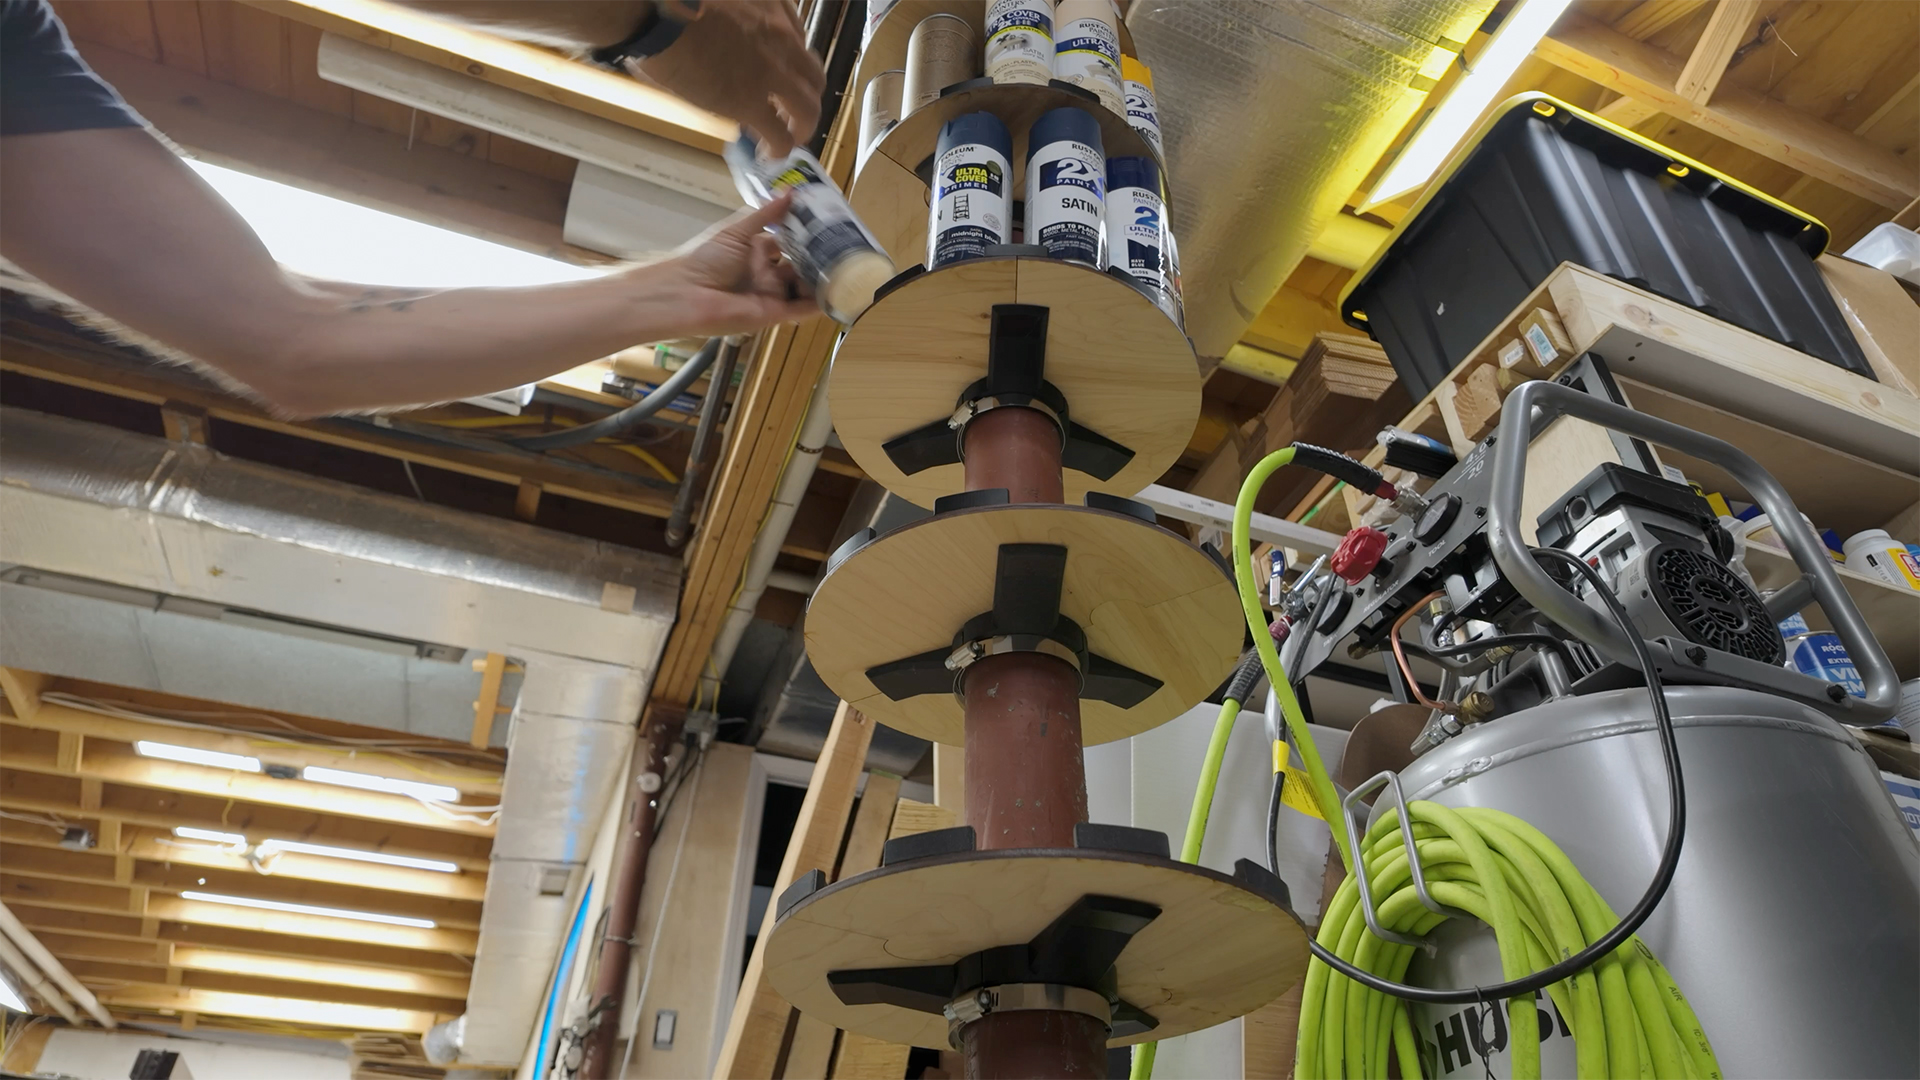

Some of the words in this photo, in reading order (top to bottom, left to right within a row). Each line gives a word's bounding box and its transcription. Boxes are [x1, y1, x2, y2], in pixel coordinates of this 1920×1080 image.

[1007, 10, 1041, 21] COVER
[1072, 38, 1105, 48] ULTRA
[1129, 110, 1150, 120] AINT
[955, 167, 988, 178] ULTRA
[1056, 158, 1103, 191] 2X
[955, 174, 988, 184] COVER
[1057, 178, 1090, 188] PAINT
[944, 182, 988, 195] PRIMER
[1062, 198, 1098, 217] SATIN
[1043, 224, 1066, 234] BONDS
[1129, 226, 1160, 237] ULTRA
[1135, 232, 1155, 241] PAINT
[1466, 442, 1486, 464] 4.0
[1468, 460, 1483, 480] 20
[1428, 539, 1446, 557] TOOL
[1362, 579, 1399, 613] REGULATOR
[1669, 986, 1683, 1002] AIR
